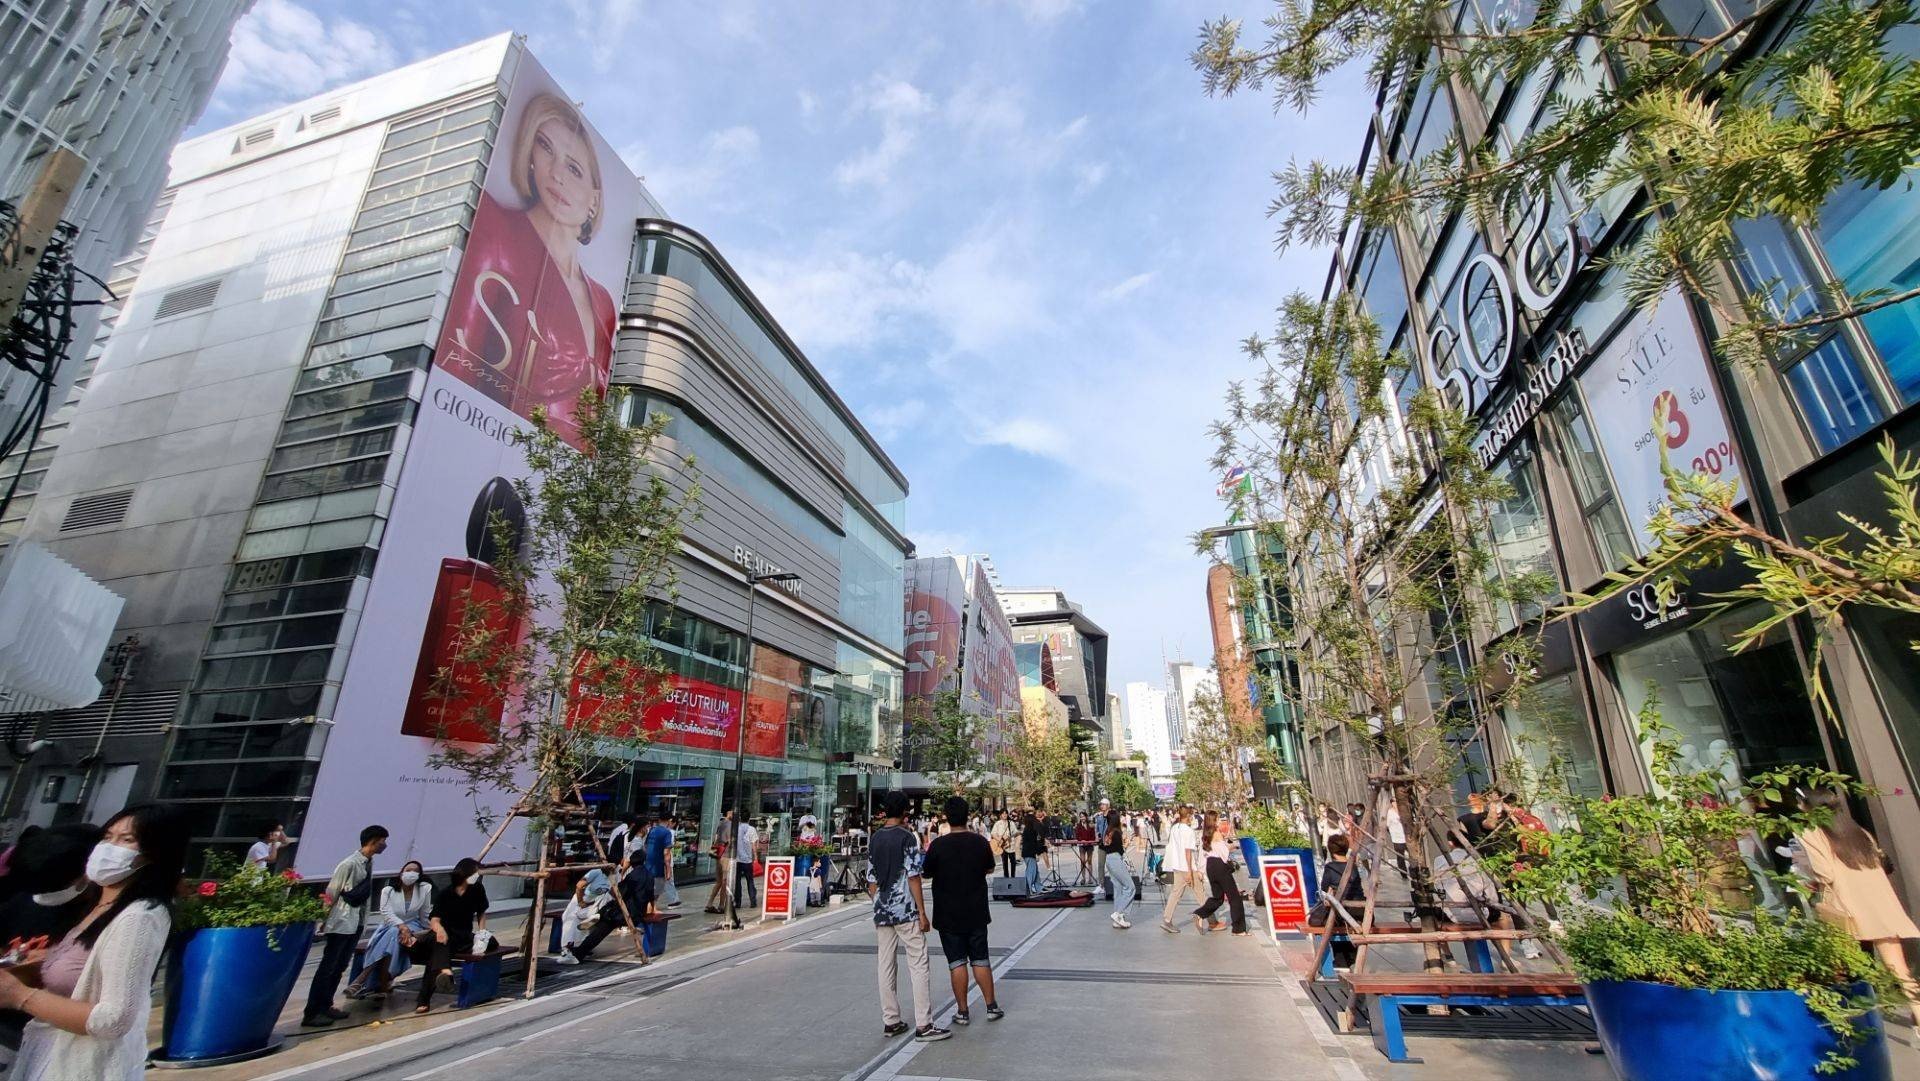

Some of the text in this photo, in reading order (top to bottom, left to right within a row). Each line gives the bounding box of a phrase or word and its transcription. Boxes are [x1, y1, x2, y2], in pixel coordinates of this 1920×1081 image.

[1616, 326, 1674, 395] SALE
[433, 387, 516, 447] GIORGIO
[1473, 326, 1591, 471] LAGSHIP STORE
[666, 688, 730, 715] BEAUTRIUM
